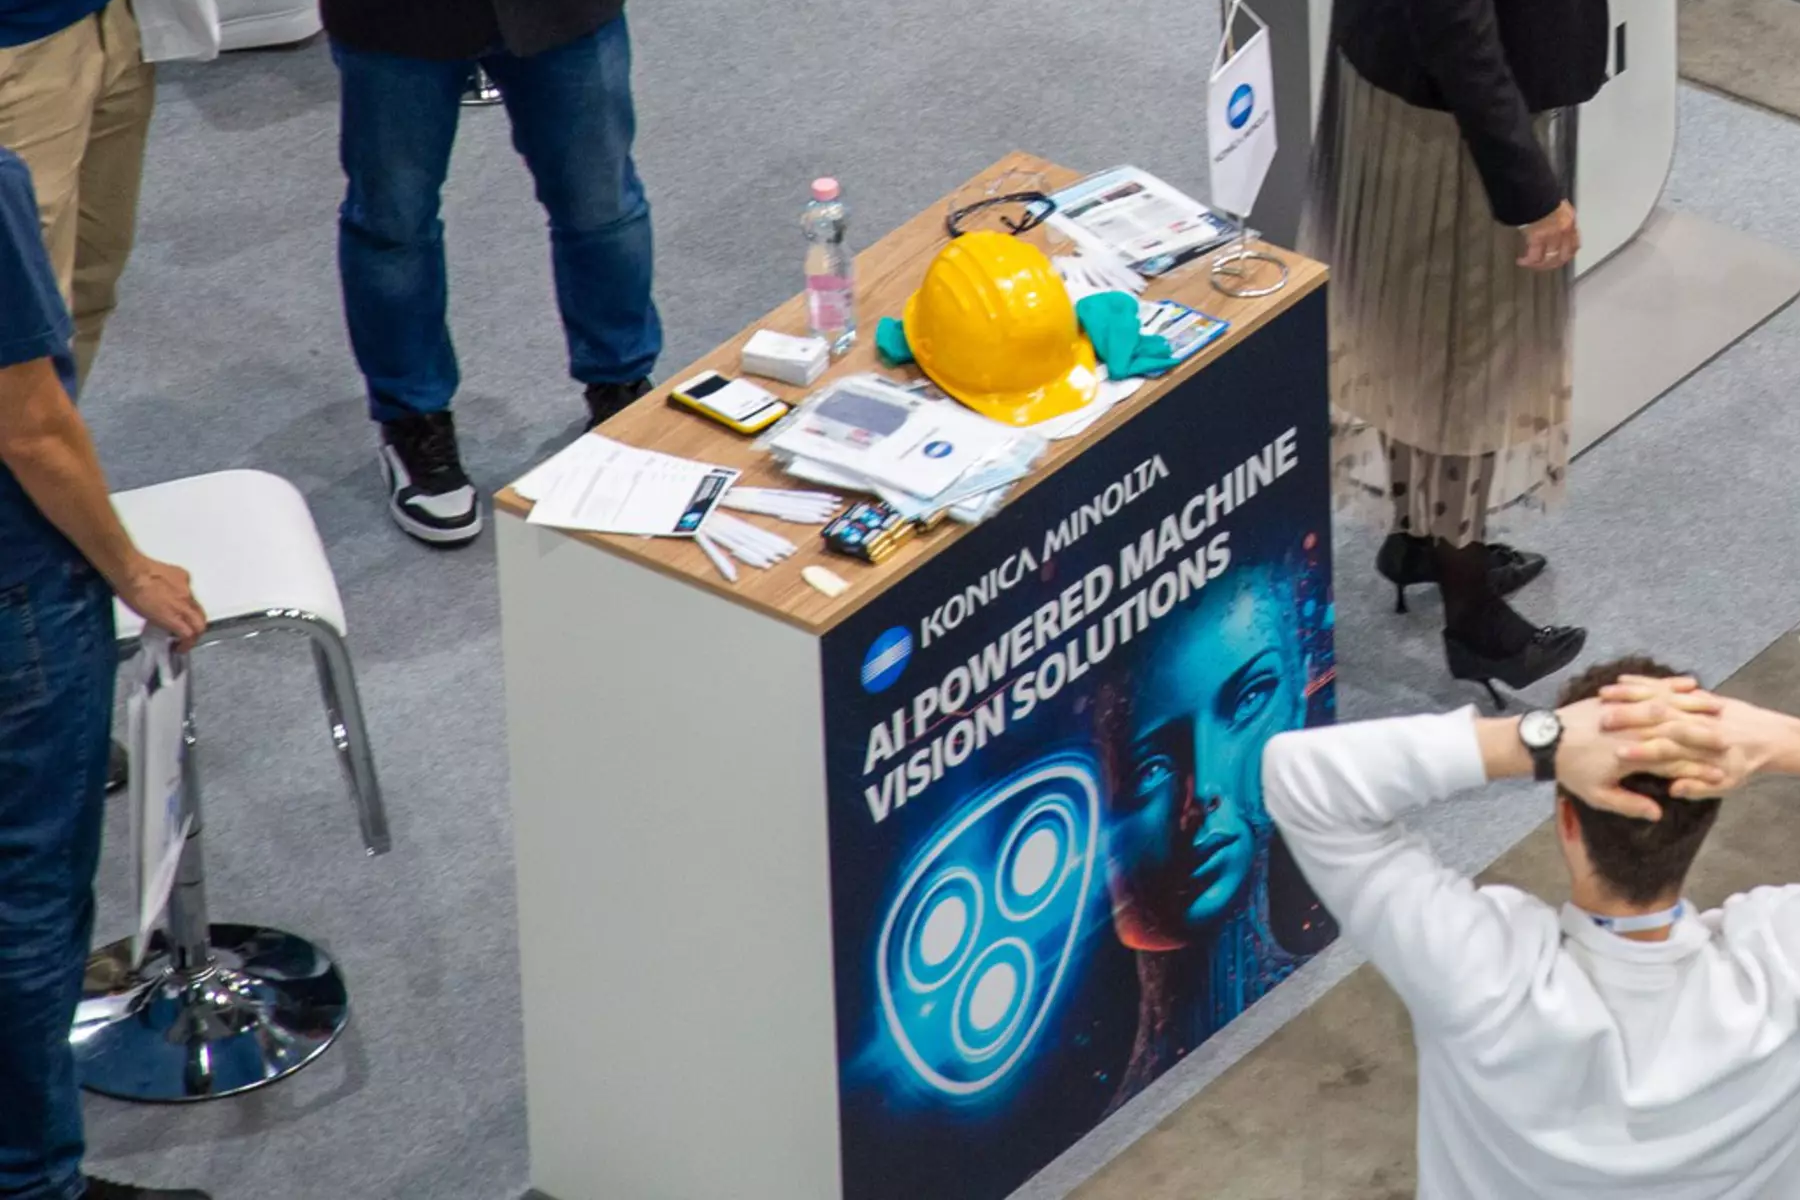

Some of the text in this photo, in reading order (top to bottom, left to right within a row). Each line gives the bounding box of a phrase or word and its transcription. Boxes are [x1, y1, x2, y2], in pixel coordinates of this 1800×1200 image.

[863, 426, 1299, 775] AI POWERED MACHINE
[864, 530, 1232, 825] VISION SOLUTIONS
[919, 453, 1171, 649] KONICA MINOLTA
